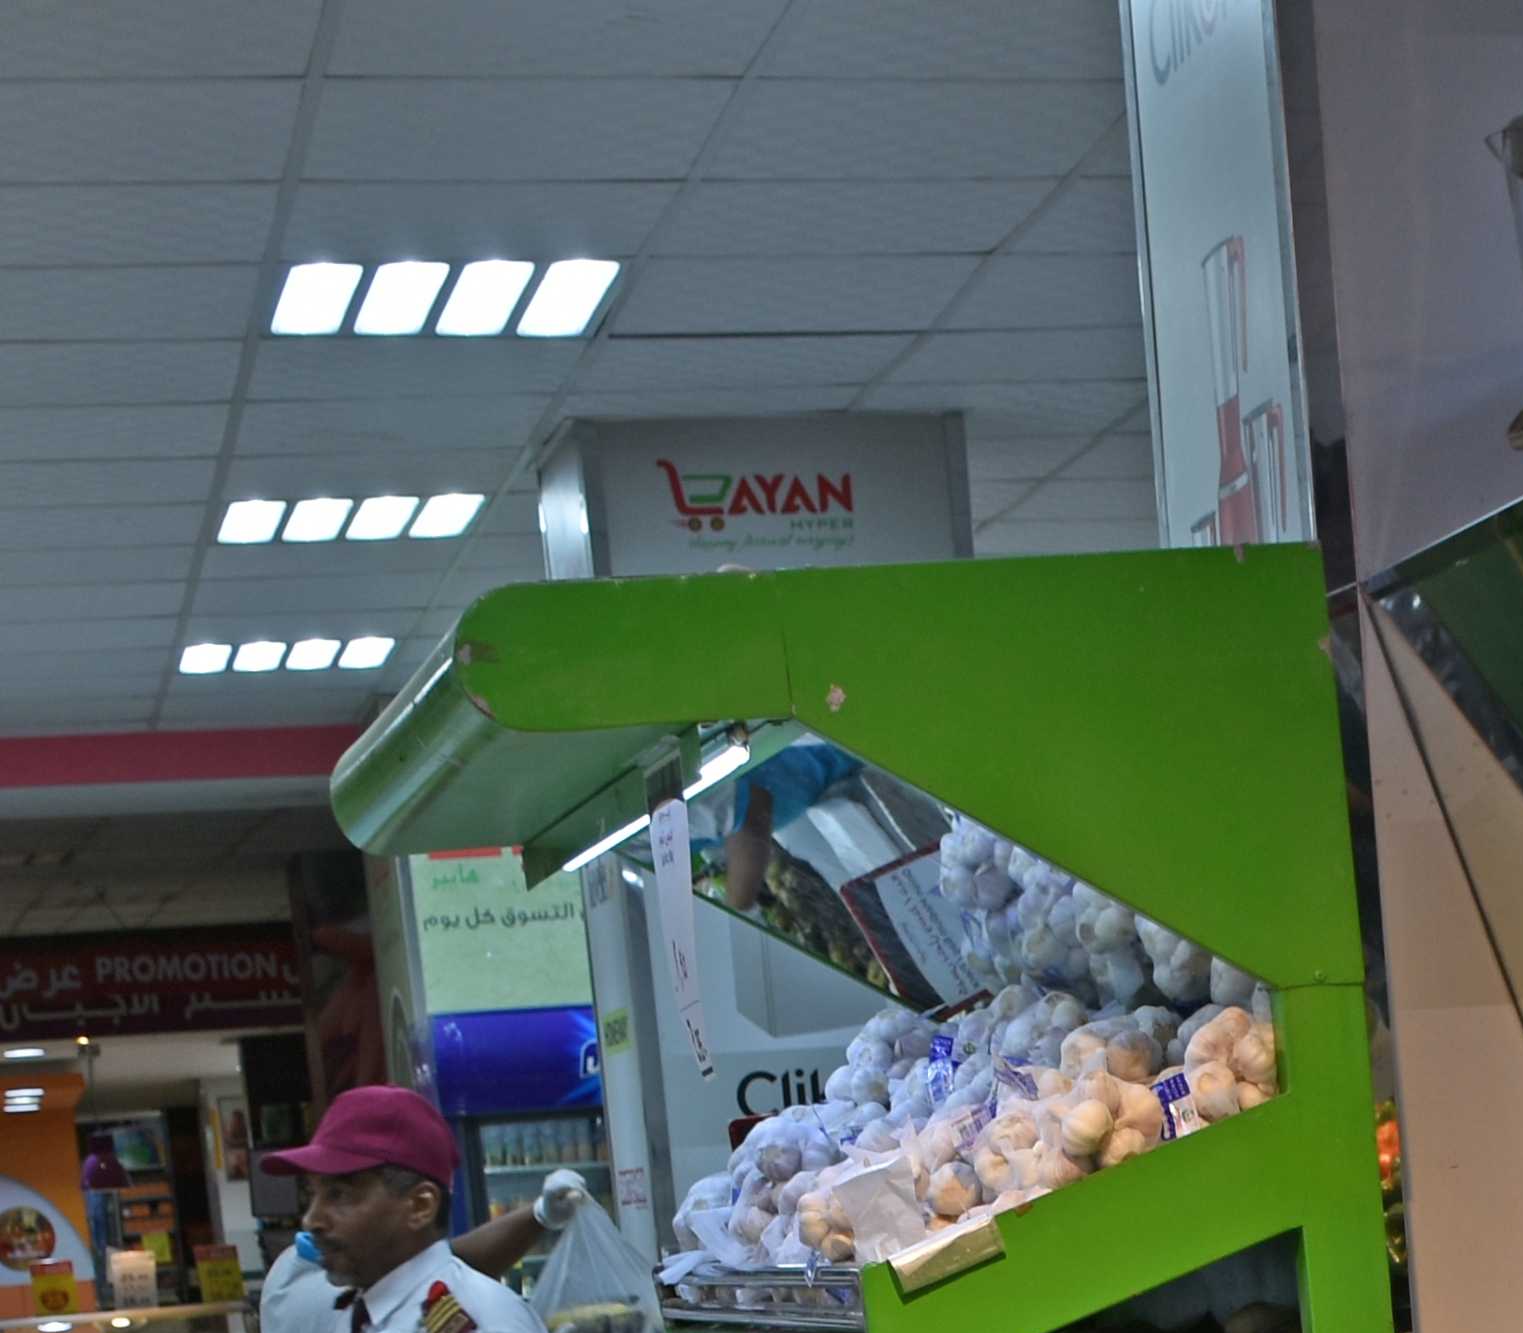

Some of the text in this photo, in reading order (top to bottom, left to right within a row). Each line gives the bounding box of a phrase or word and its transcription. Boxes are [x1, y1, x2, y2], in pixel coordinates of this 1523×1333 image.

[423, 914, 460, 931] يوم
[466, 907, 495, 930] كل
[96, 953, 278, 984] PROMOTION
